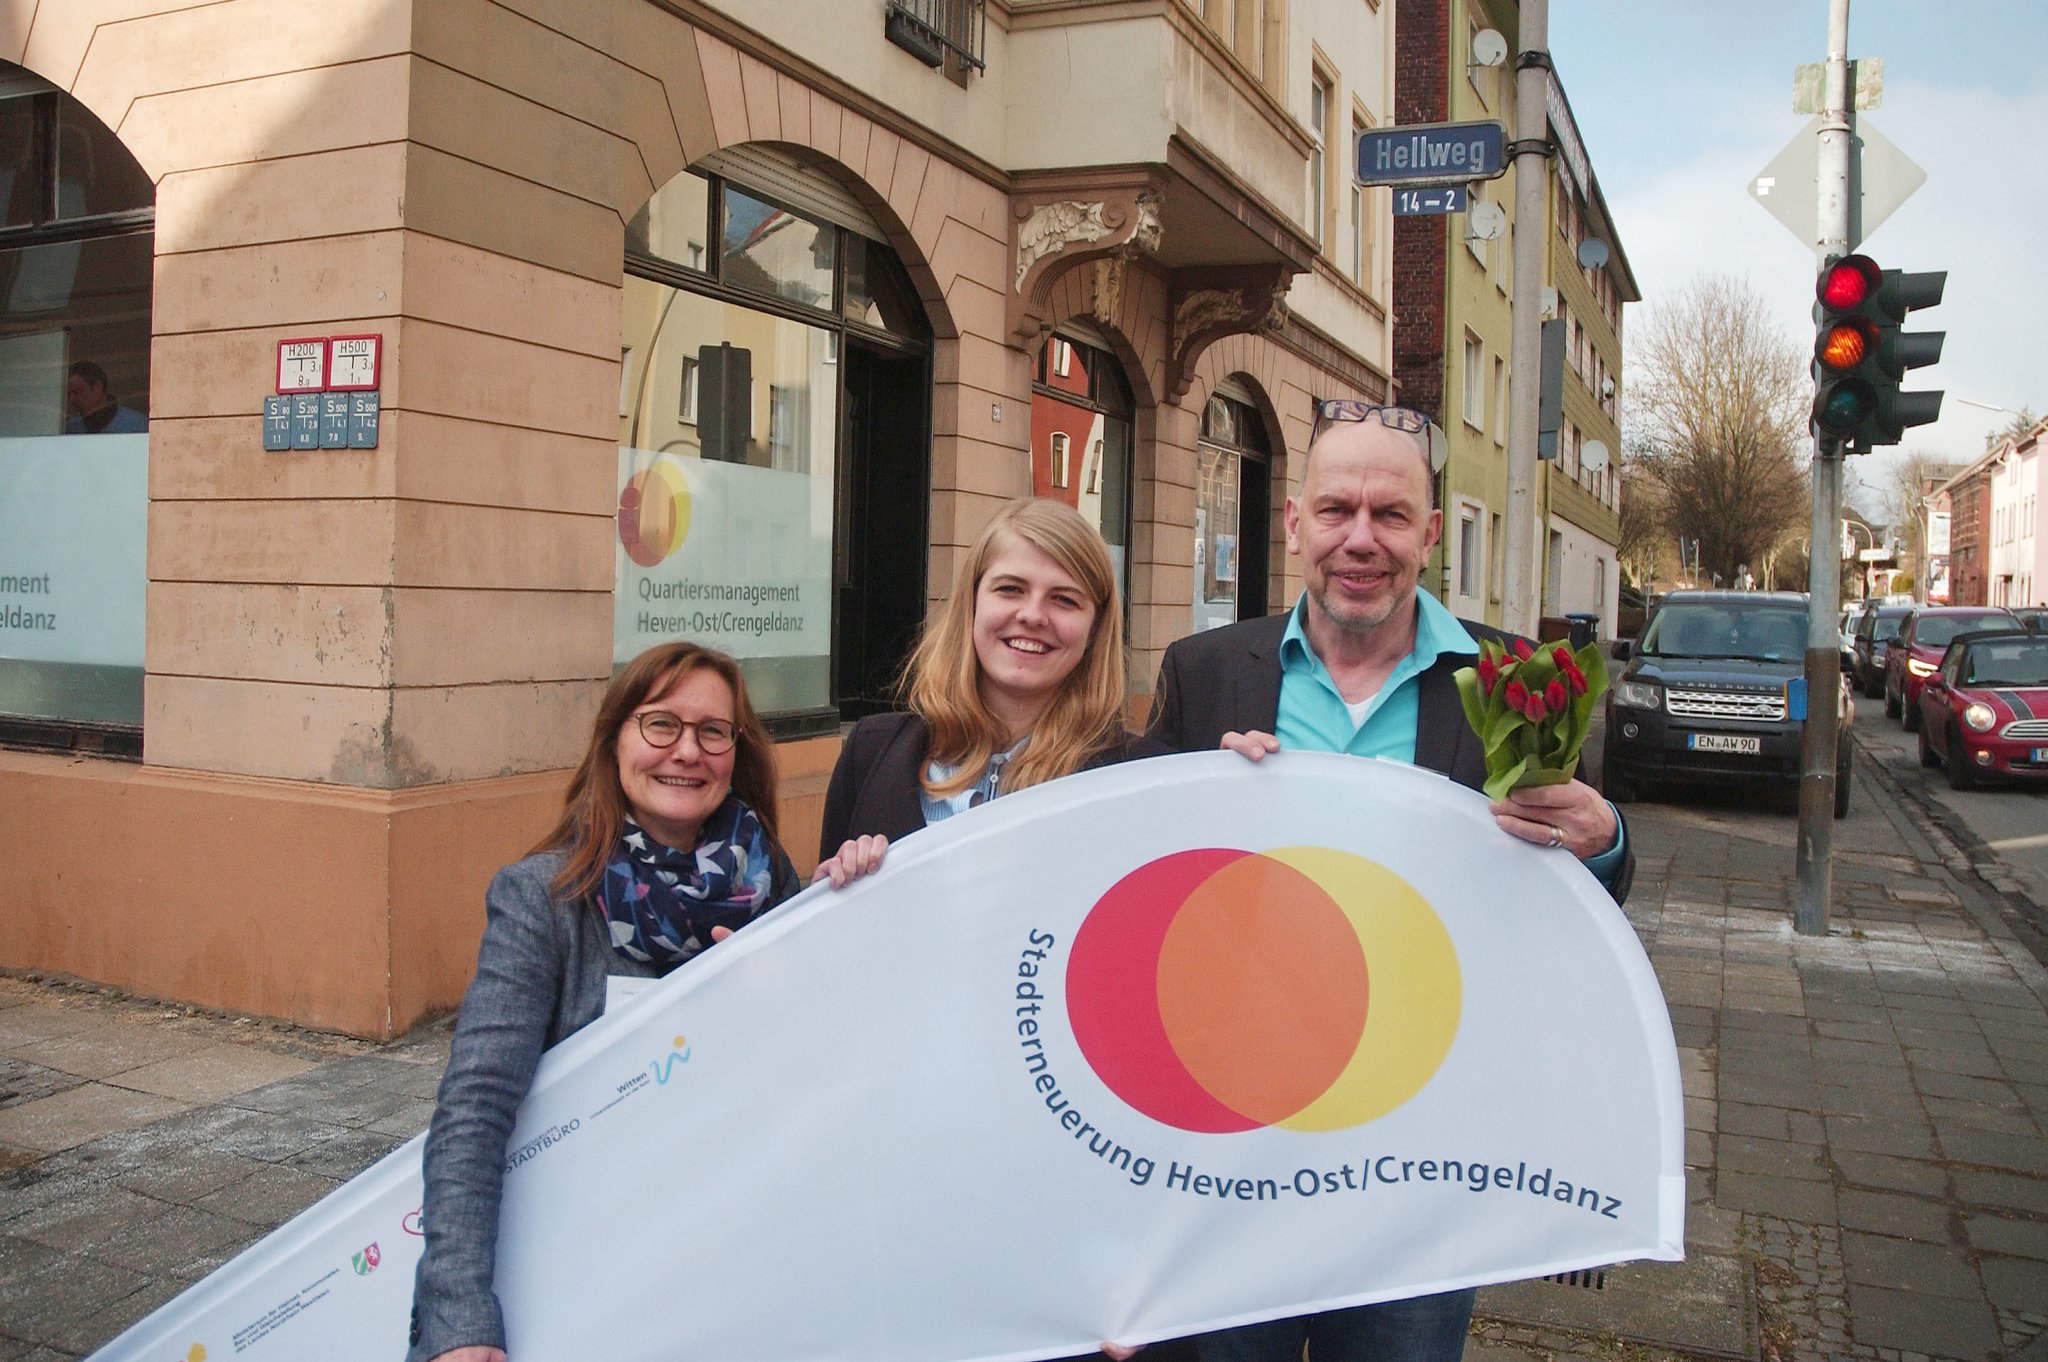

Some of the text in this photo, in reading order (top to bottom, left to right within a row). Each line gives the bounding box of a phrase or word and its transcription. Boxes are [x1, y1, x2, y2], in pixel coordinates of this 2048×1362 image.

[1376, 136, 1485, 173] Hellweg
[288, 343, 315, 356] H200
[340, 340, 367, 353] H500
[639, 577, 801, 606] Quartiersmanagement
[637, 611, 804, 637] Heven-Ost/Crengeldanz
[616, 1072, 648, 1093] Witten
[1015, 928, 1623, 1220] Stadterneuerung Heven-Ost/Crengeldanz
[504, 1118, 581, 1174] STADTBÜRO
